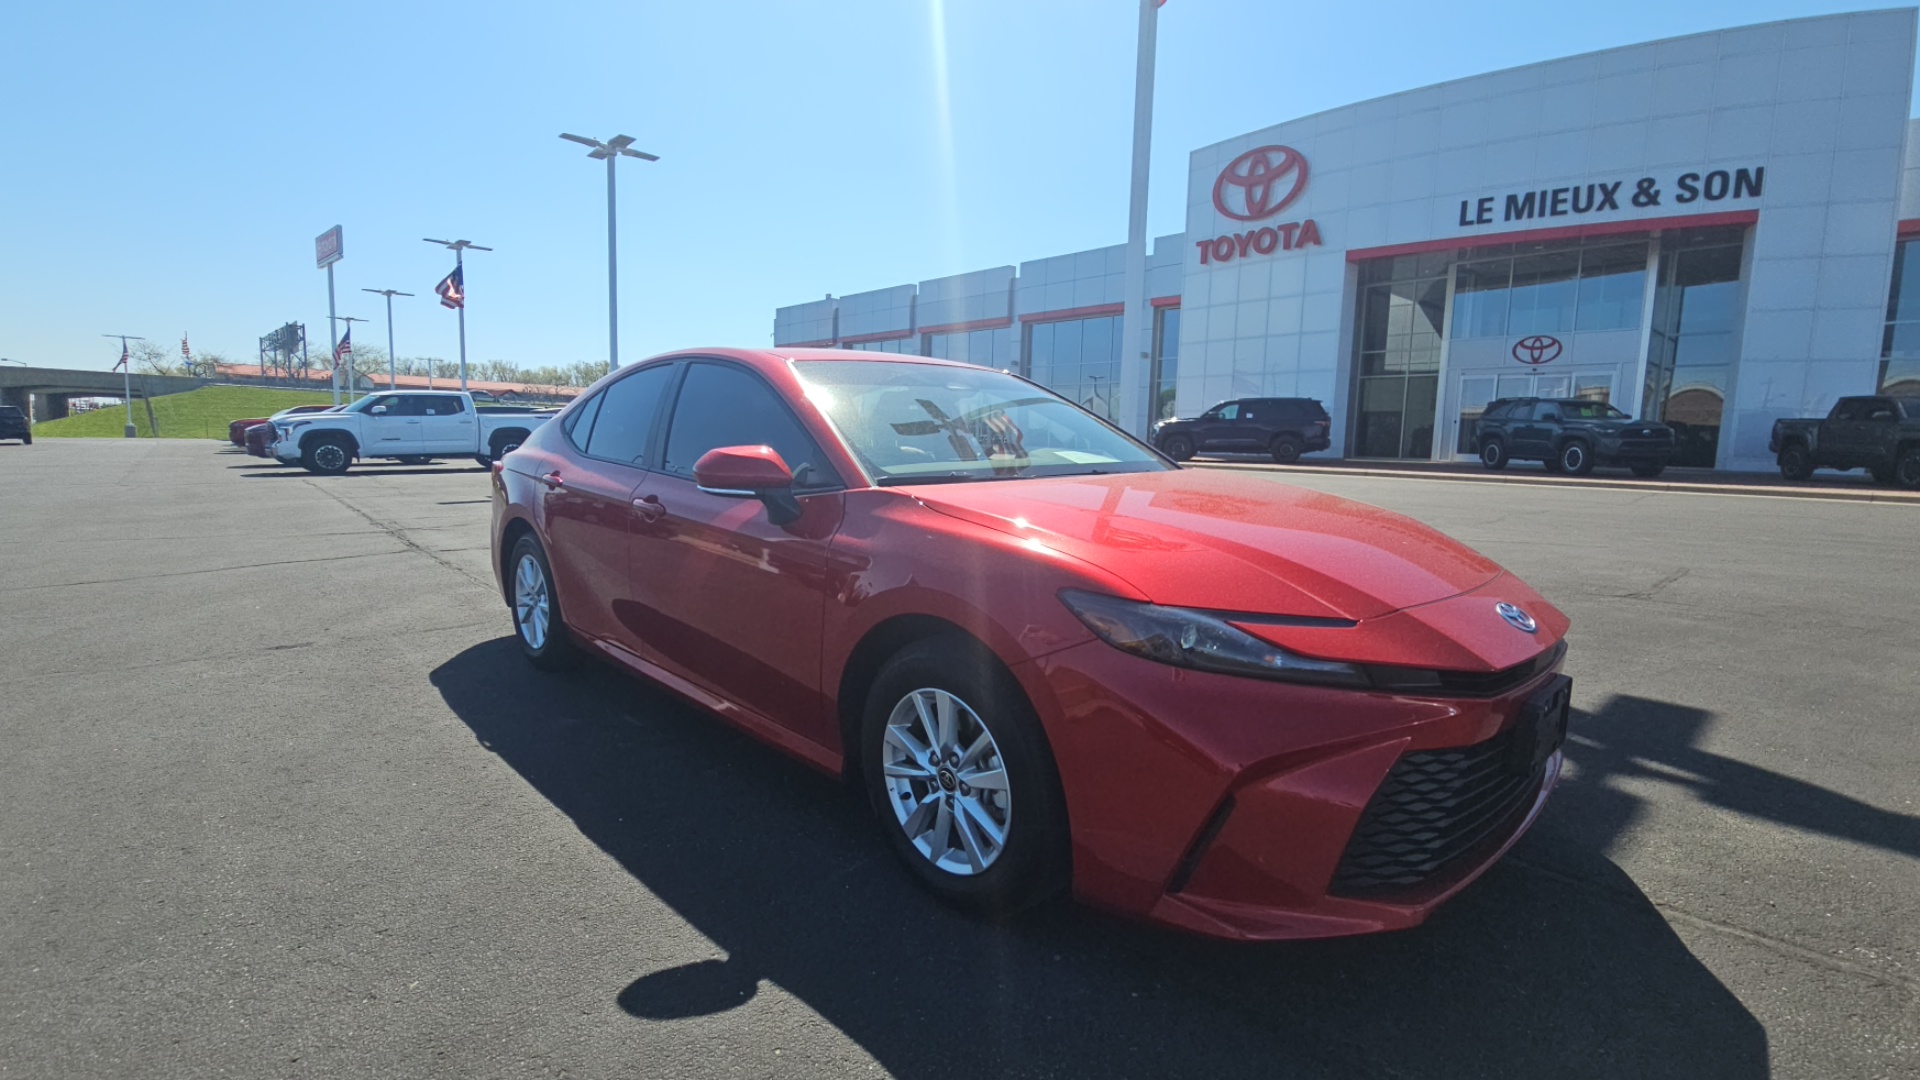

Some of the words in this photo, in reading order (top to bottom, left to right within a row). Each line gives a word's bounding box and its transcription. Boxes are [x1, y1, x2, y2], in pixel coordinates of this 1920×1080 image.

[1459, 197, 1494, 226] LE
[1504, 181, 1622, 221] MIEUX
[1631, 177, 1661, 207] &
[1675, 167, 1765, 203] SON
[1196, 219, 1322, 265] TOYOTA
